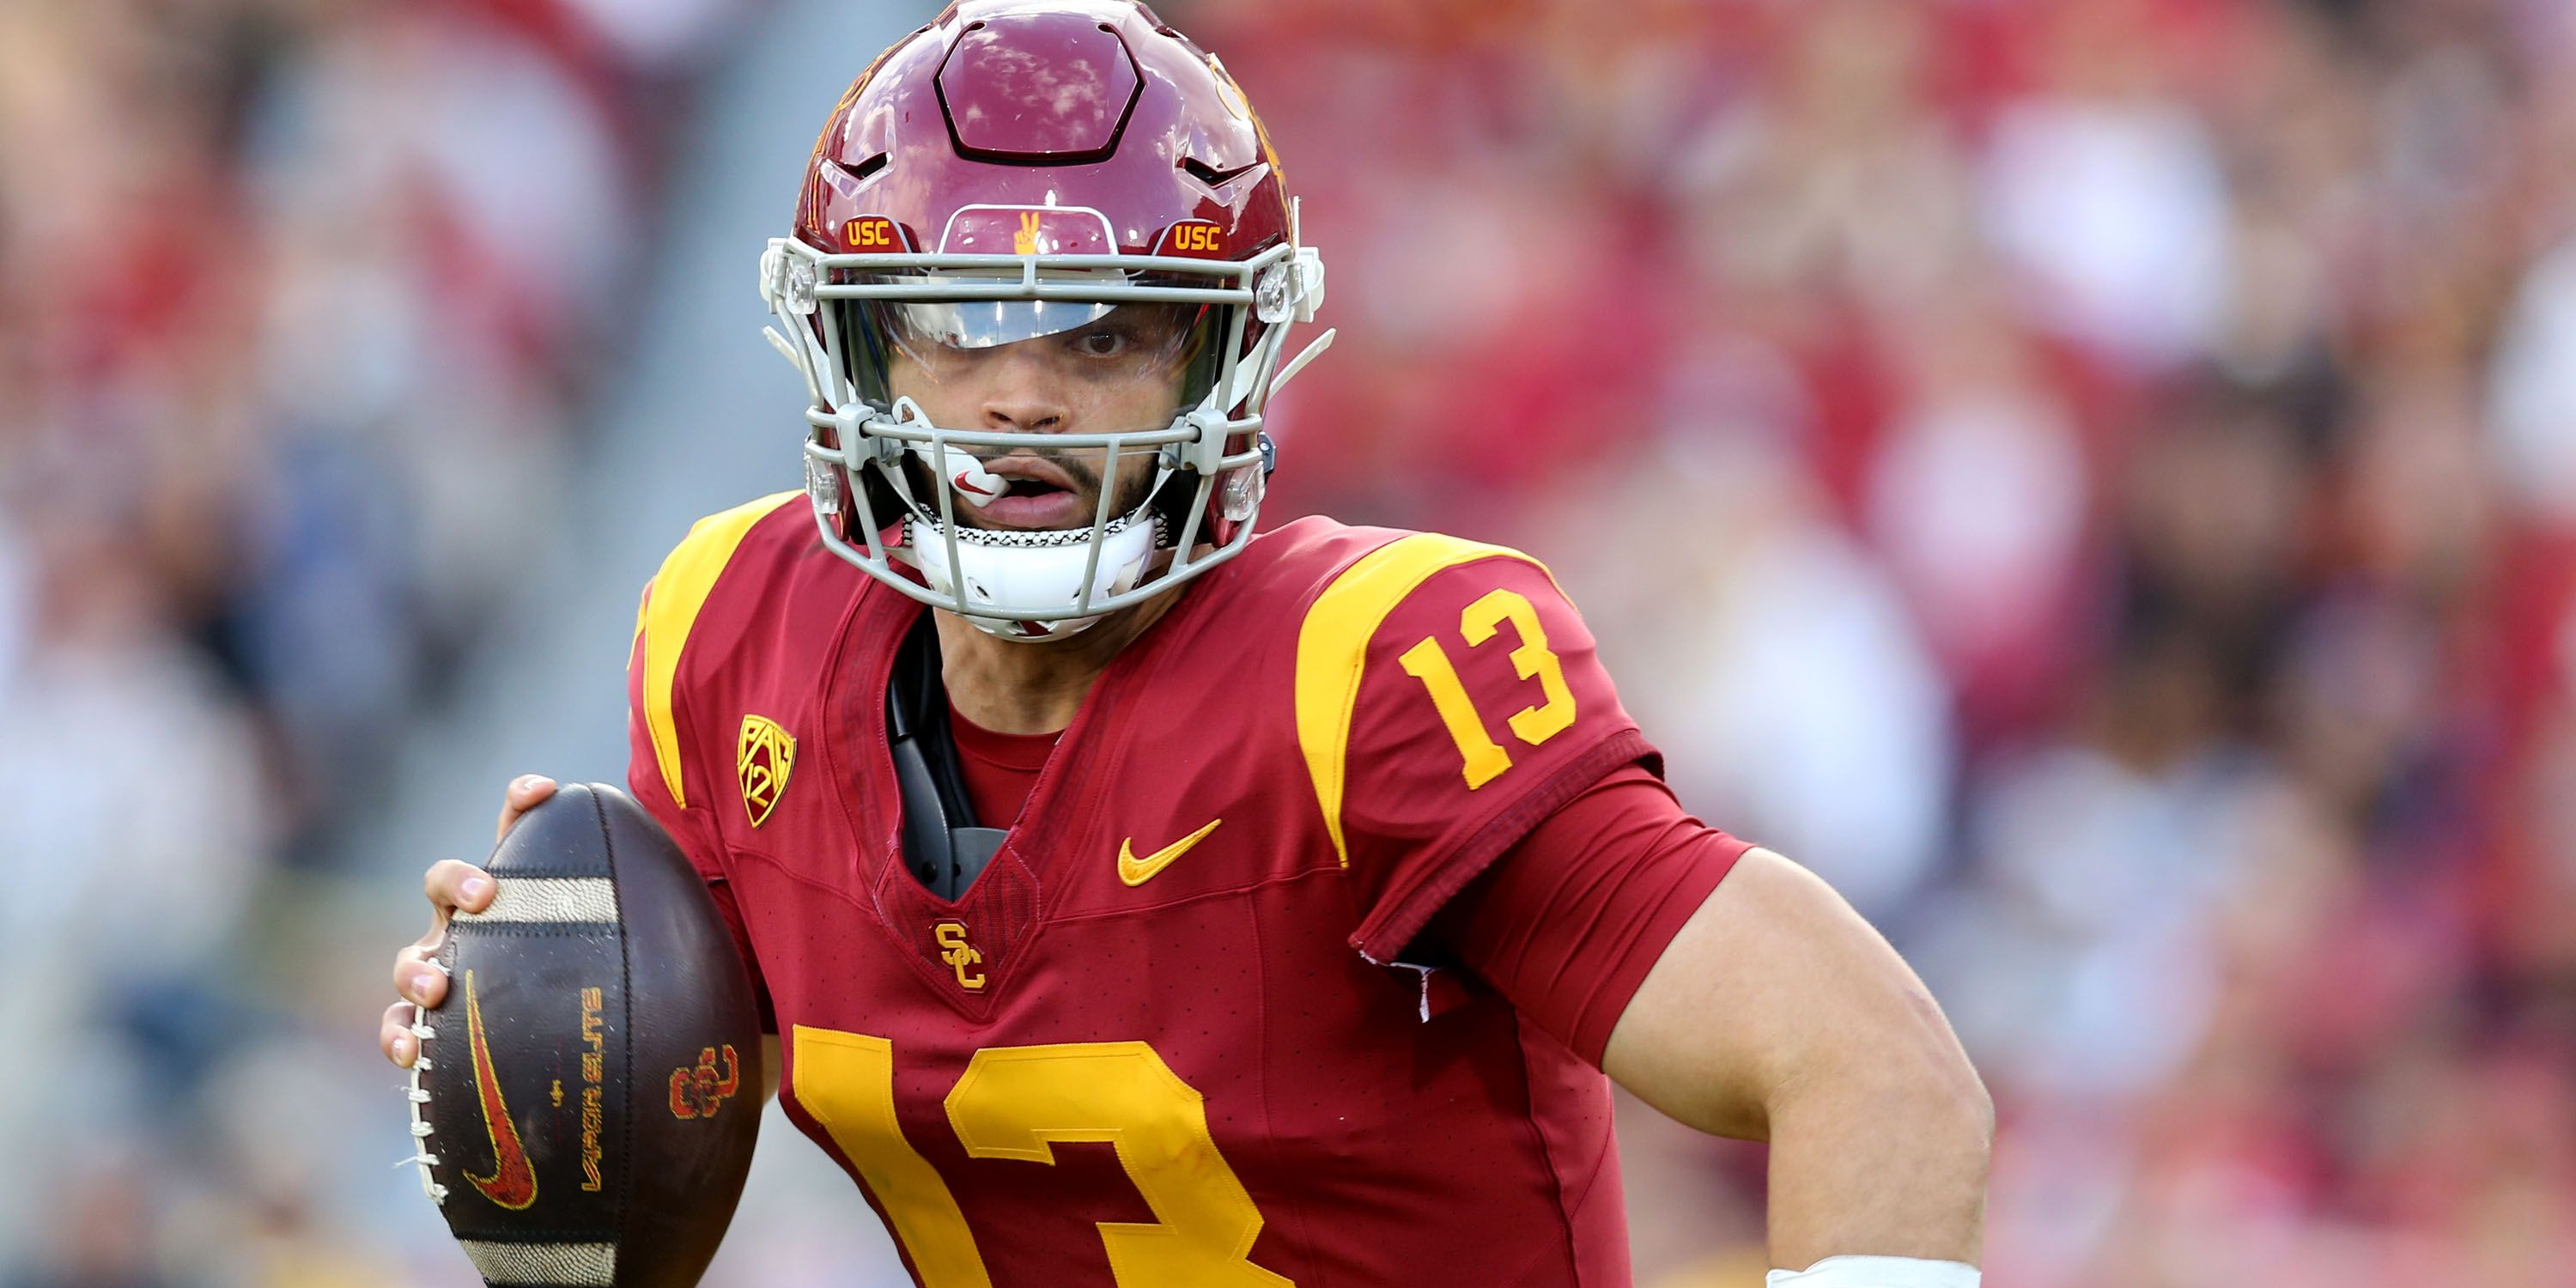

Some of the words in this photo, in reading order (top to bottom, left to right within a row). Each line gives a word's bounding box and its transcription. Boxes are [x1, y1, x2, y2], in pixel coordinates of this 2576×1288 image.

[847, 220, 890, 246] USC
[1175, 225, 1221, 251] USC
[1398, 587, 1577, 791] 13
[739, 720, 793, 795] PAC
[745, 762, 772, 808] 12
[935, 923, 986, 988] SC
[580, 987, 603, 1083] ELITE
[580, 1085, 603, 1191] VAPOR
[792, 1024, 1297, 1288] 13
